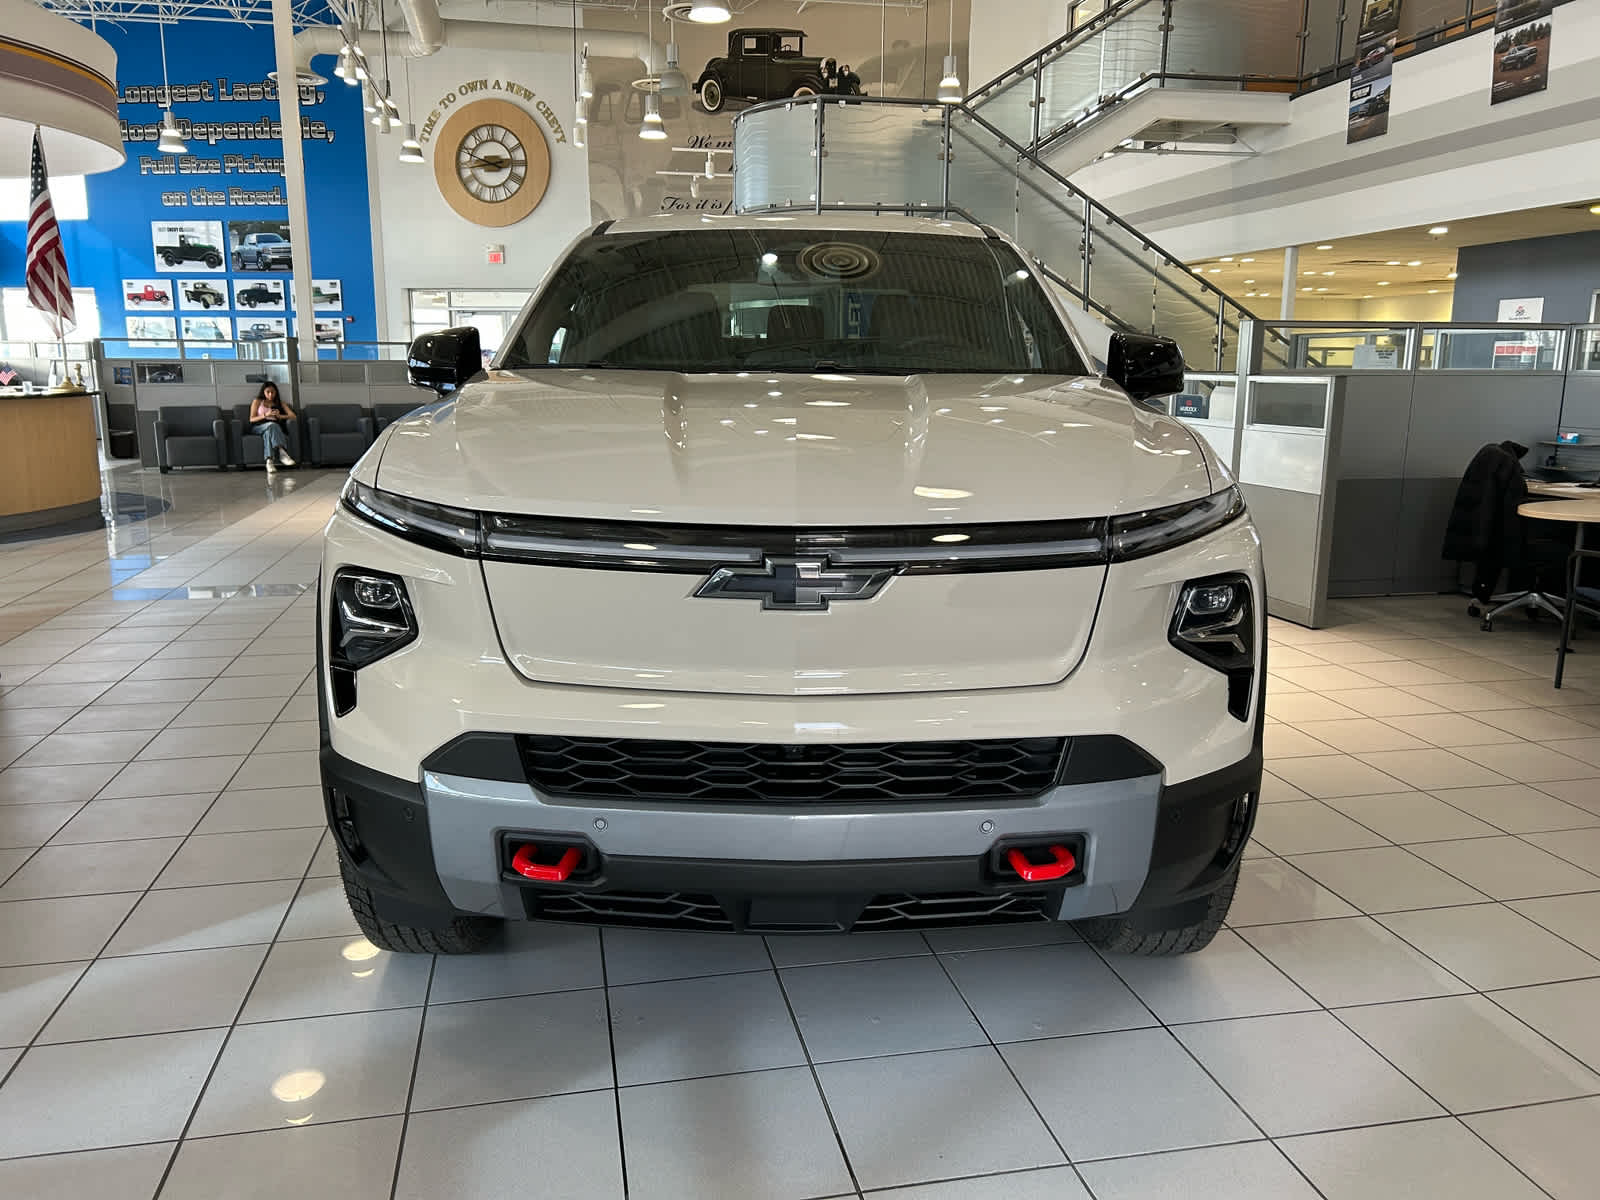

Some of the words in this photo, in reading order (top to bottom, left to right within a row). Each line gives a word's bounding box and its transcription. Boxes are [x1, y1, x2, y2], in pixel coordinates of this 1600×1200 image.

[419, 110, 441, 143] TIME
[439, 92, 457, 109] TO
[458, 79, 488, 96] OWN
[492, 79, 502, 90] A
[505, 81, 536, 101] NEW
[535, 100, 567, 144] CHEVY
[175, 116, 335, 145] Dependale,
[687, 134, 713, 149] We
[139, 155, 176, 174] Full
[178, 154, 221, 174] Size
[161, 191, 188, 207] on
[190, 187, 226, 206] the
[229, 186, 288, 207] Road.
[661, 196, 690, 211] For
[695, 199, 709, 211] it
[710, 199, 722, 211] is
